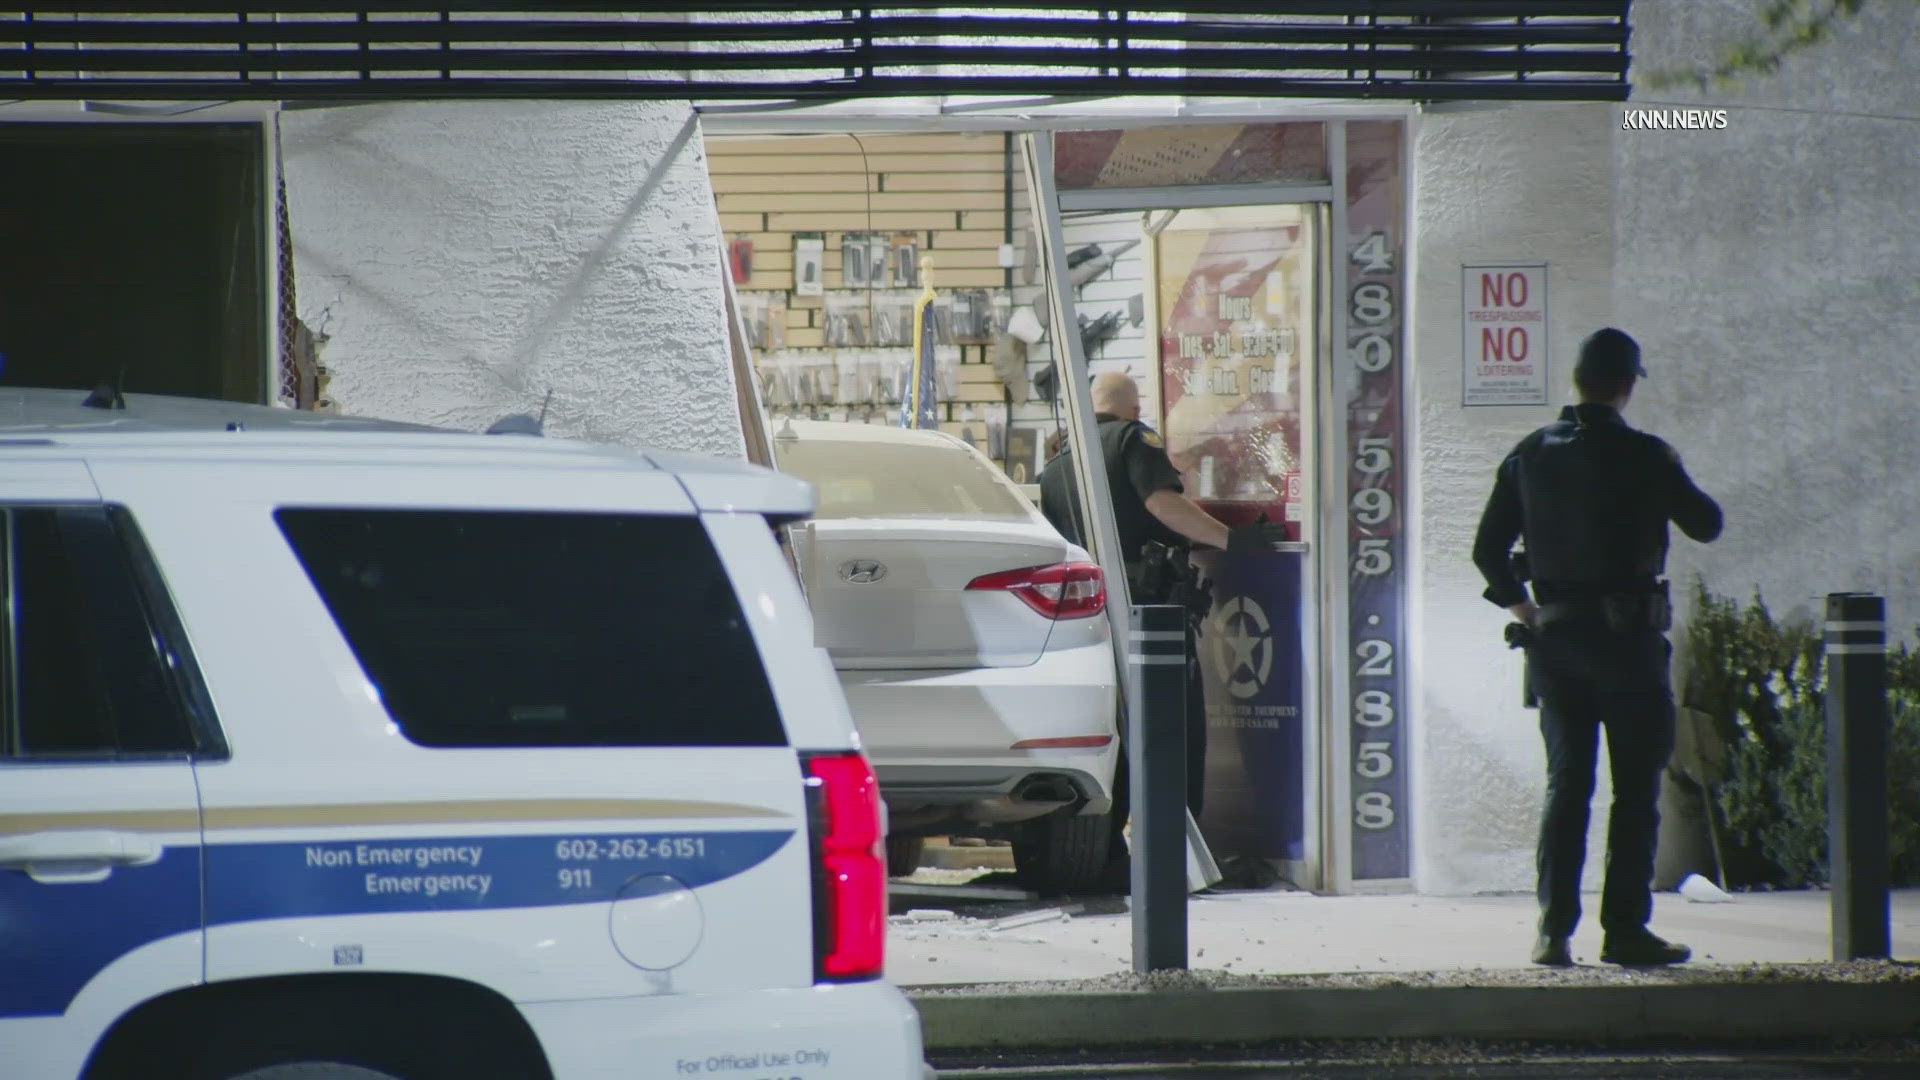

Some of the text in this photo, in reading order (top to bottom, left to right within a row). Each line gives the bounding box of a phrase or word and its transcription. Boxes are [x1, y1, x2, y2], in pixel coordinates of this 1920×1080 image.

[1481, 271, 1529, 308] NO
[1468, 310, 1543, 322] TRESPASSING
[1481, 326, 1529, 362] NO
[1476, 364, 1534, 376] LOITERING
[305, 838, 706, 868] Non Emergency 602-262-6151
[365, 869, 592, 896] Emergency 911
[676, 1048, 831, 1074] For Official Use Only
